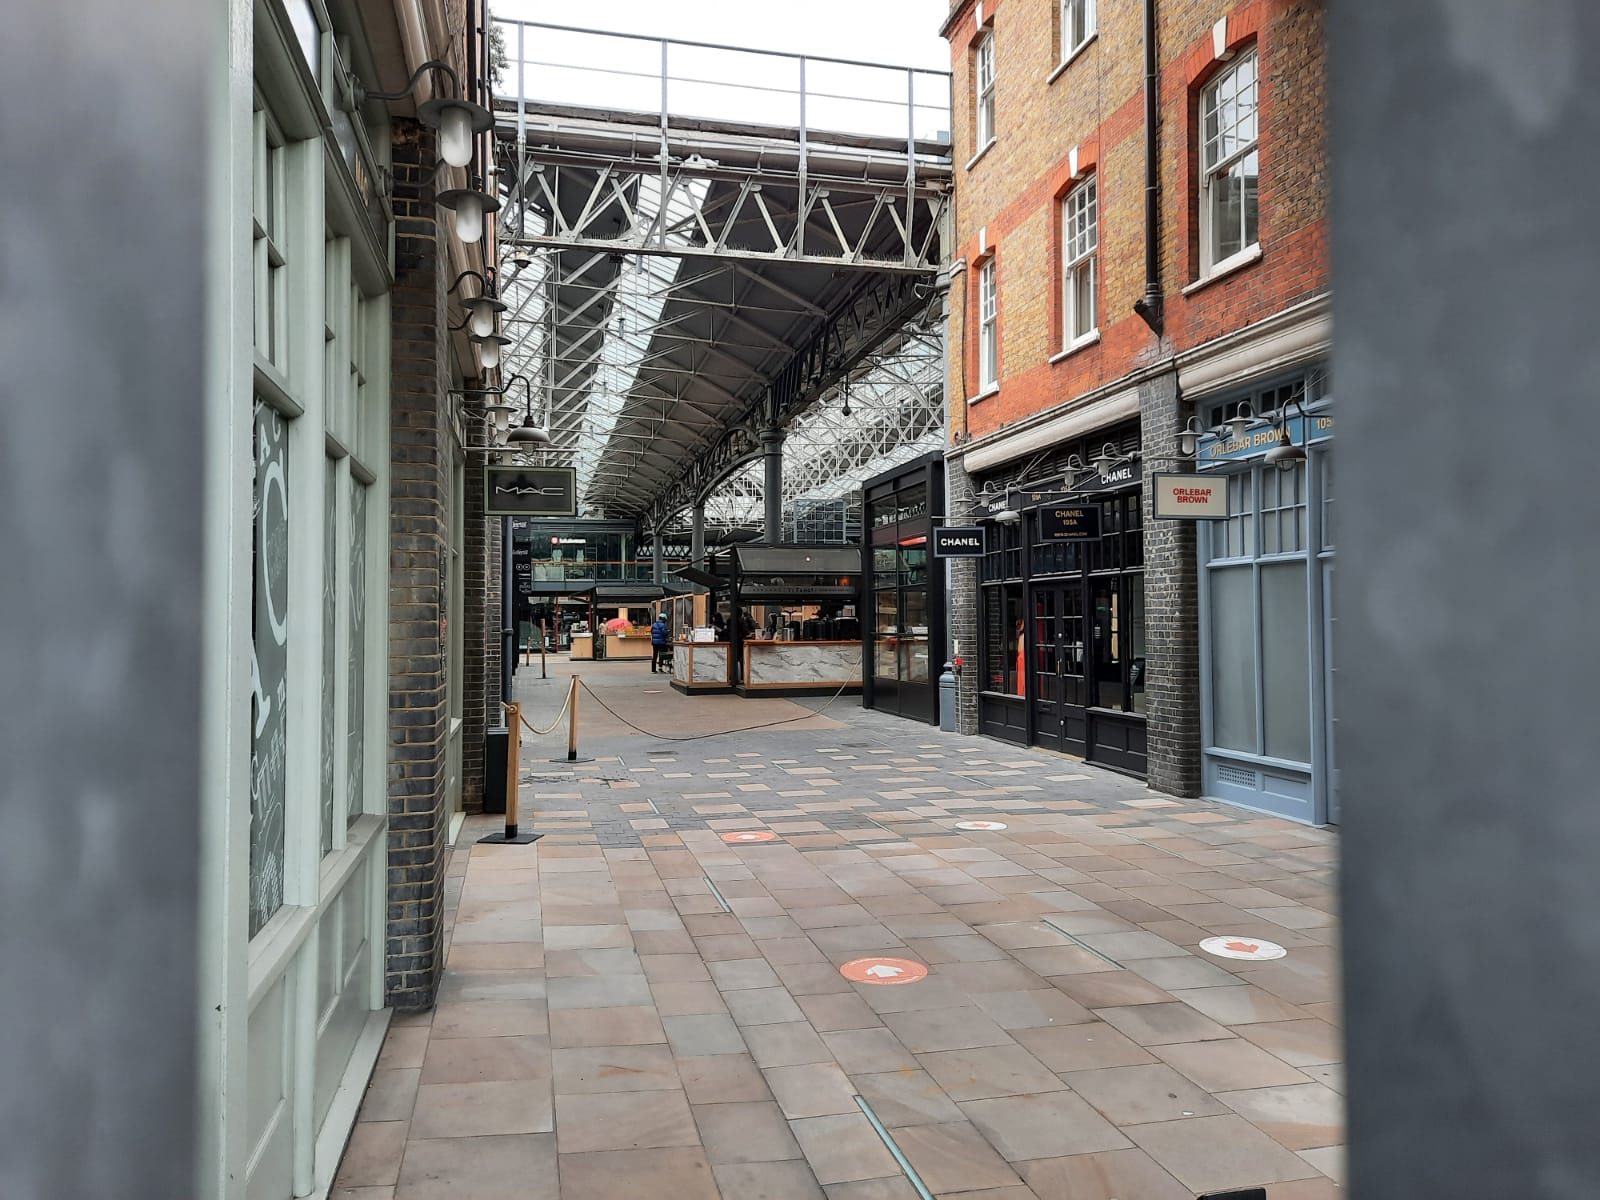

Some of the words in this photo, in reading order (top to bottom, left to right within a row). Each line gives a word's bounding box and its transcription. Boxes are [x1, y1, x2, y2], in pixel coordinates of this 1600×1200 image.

[1209, 436, 1252, 458] ORLEBAR
[1100, 467, 1133, 484] CHANEL
[1172, 488, 1212, 496] ORLEBAR
[1176, 495, 1208, 504] BROWN
[988, 499, 1008, 513] CHANE
[1055, 510, 1085, 518] CHANEL
[940, 537, 981, 547] CHANEL
